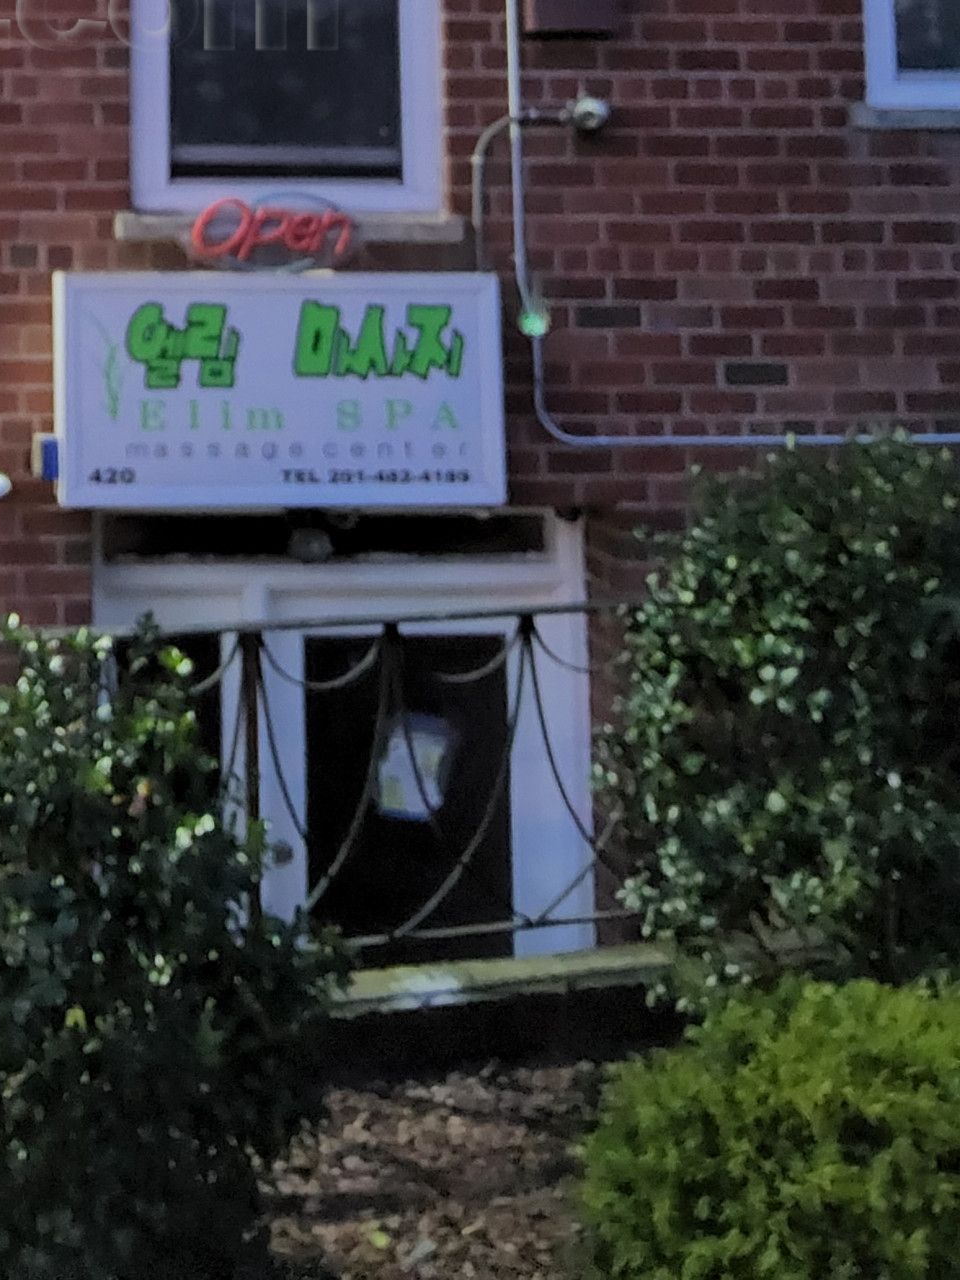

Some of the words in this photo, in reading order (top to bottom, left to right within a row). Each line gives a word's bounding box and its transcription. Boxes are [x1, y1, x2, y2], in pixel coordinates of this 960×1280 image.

[191, 197, 353, 261] Open
[294, 298, 464, 381] 마사지
[141, 399, 284, 432] Elim
[337, 399, 461, 432] SPA
[125, 441, 304, 460] massage
[321, 441, 468, 460] center
[89, 468, 136, 484] 420
[283, 469, 320, 484] TEL
